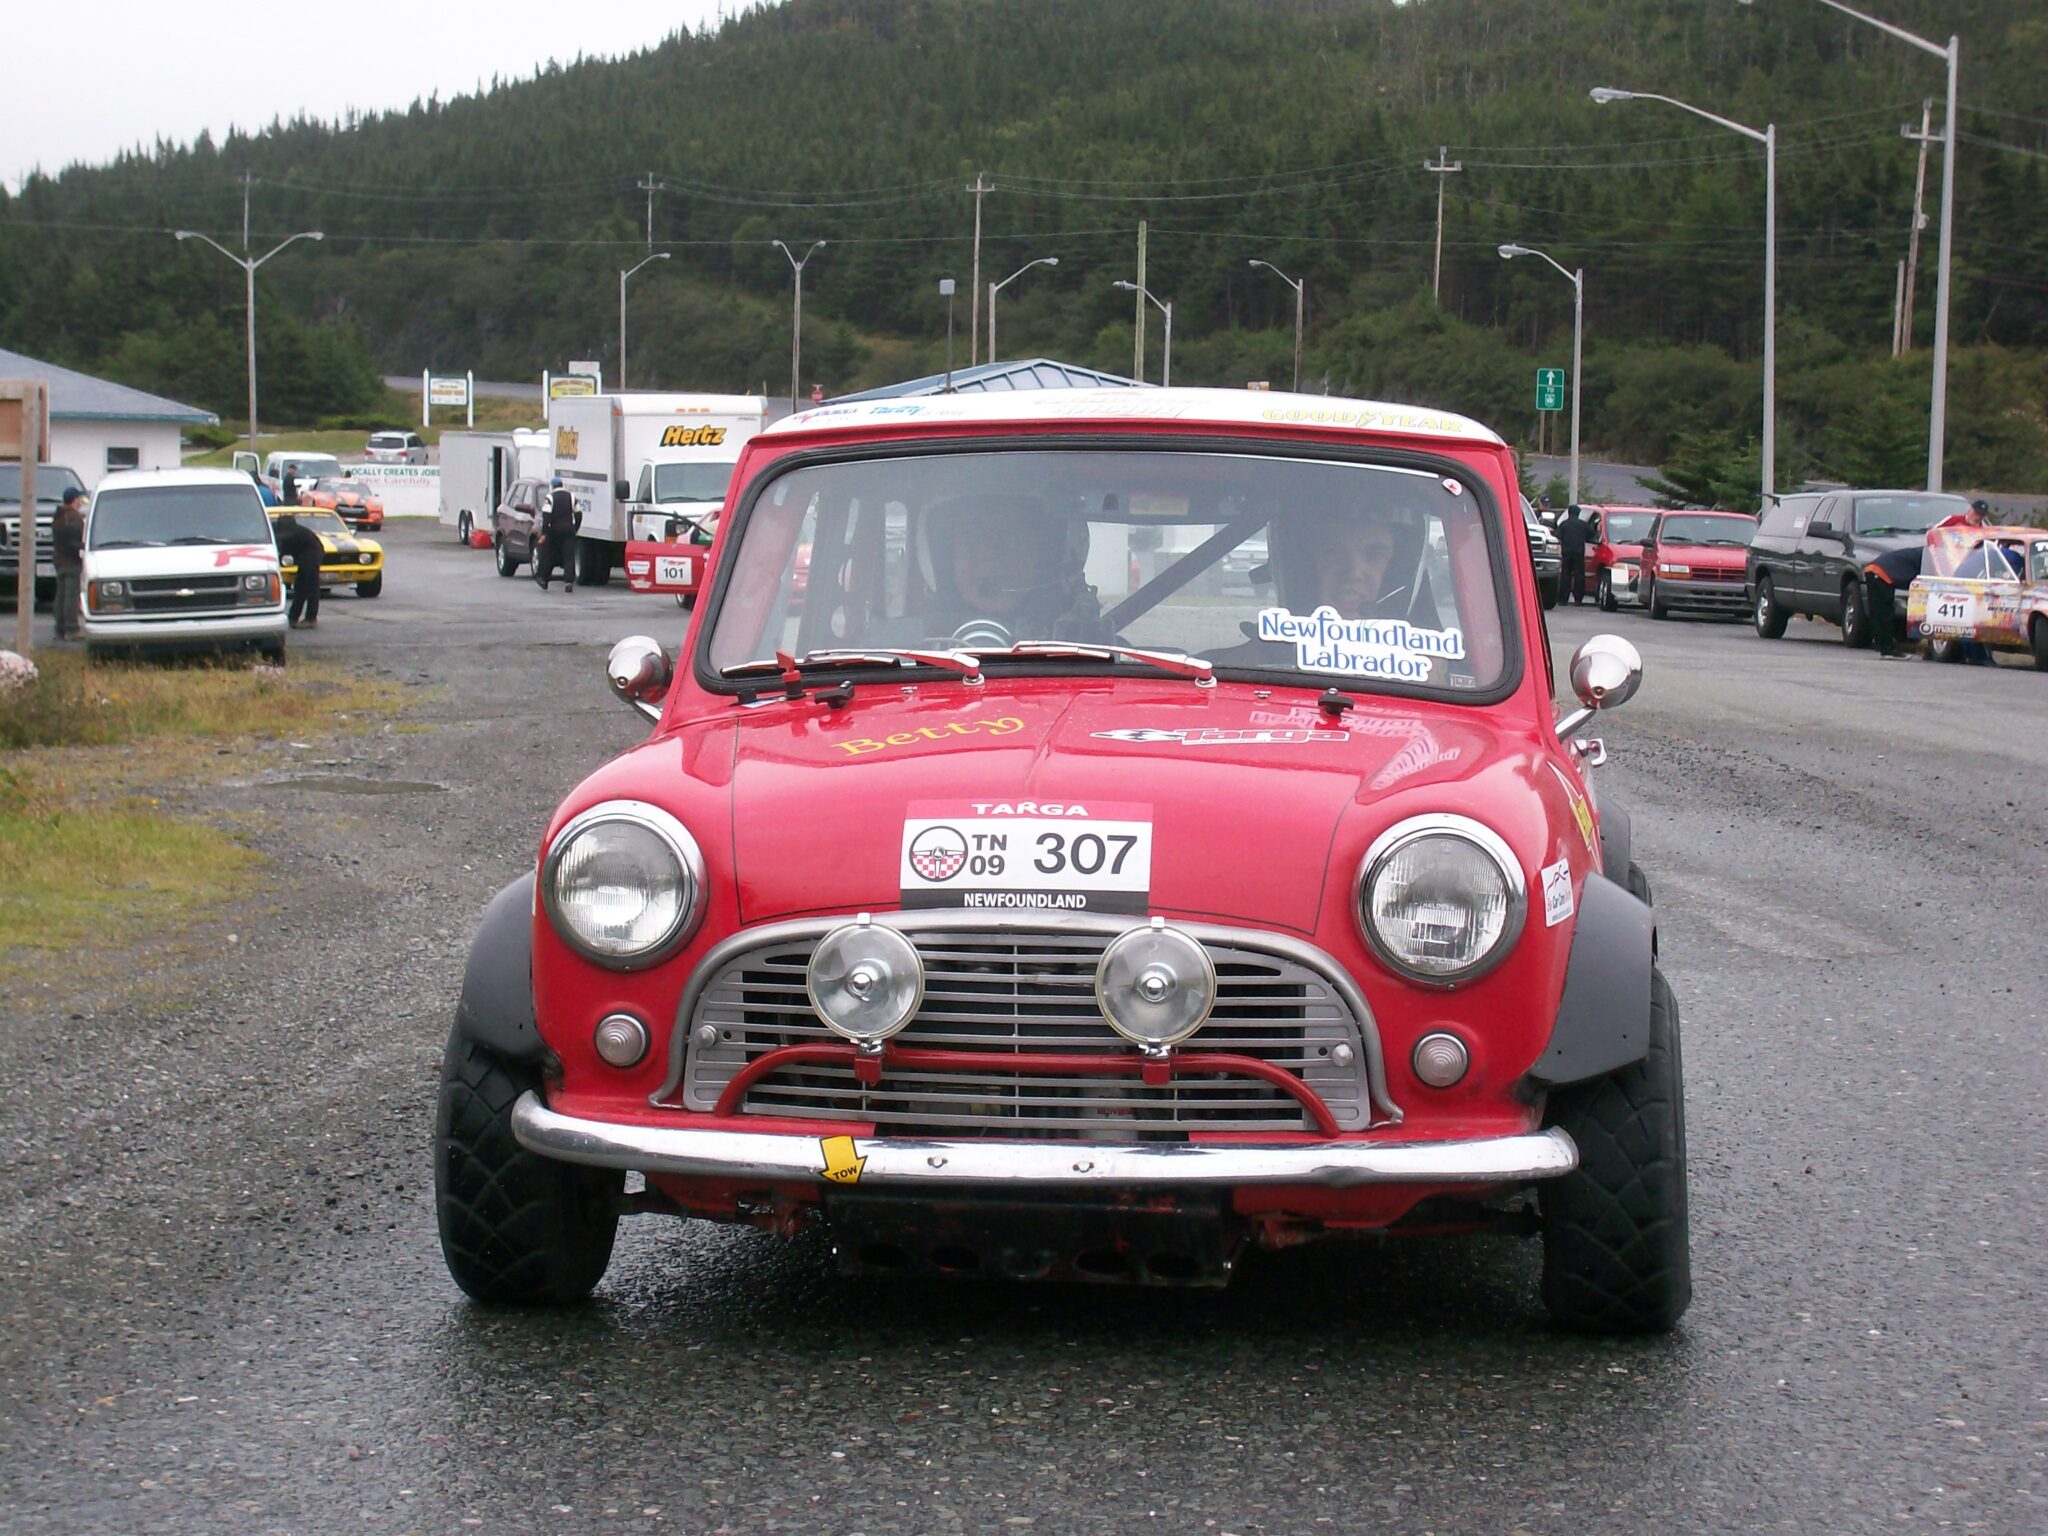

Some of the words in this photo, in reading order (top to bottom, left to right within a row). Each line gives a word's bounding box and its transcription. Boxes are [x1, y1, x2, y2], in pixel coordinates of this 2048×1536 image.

[555, 425, 580, 460] Hertz
[660, 424, 727, 447] Hertz
[350, 467, 381, 476] OCALLY
[384, 468, 419, 476] CREATES
[421, 468, 440, 477] JOBS
[384, 477, 431, 486] Carefully
[664, 567, 683, 579] 101
[1937, 603, 1965, 618] 411
[1262, 611, 1459, 655] Newfoundland
[1301, 644, 1428, 677] Labrador
[831, 716, 1025, 757] Betty
[1173, 728, 1350, 745] Targa
[971, 802, 1089, 816] TARGA
[972, 834, 1007, 851] TN
[1034, 832, 1138, 875] 307
[970, 854, 1005, 876] 09
[963, 893, 1087, 909] NEWFOUNDLAND
[832, 1165, 857, 1180] TOW
